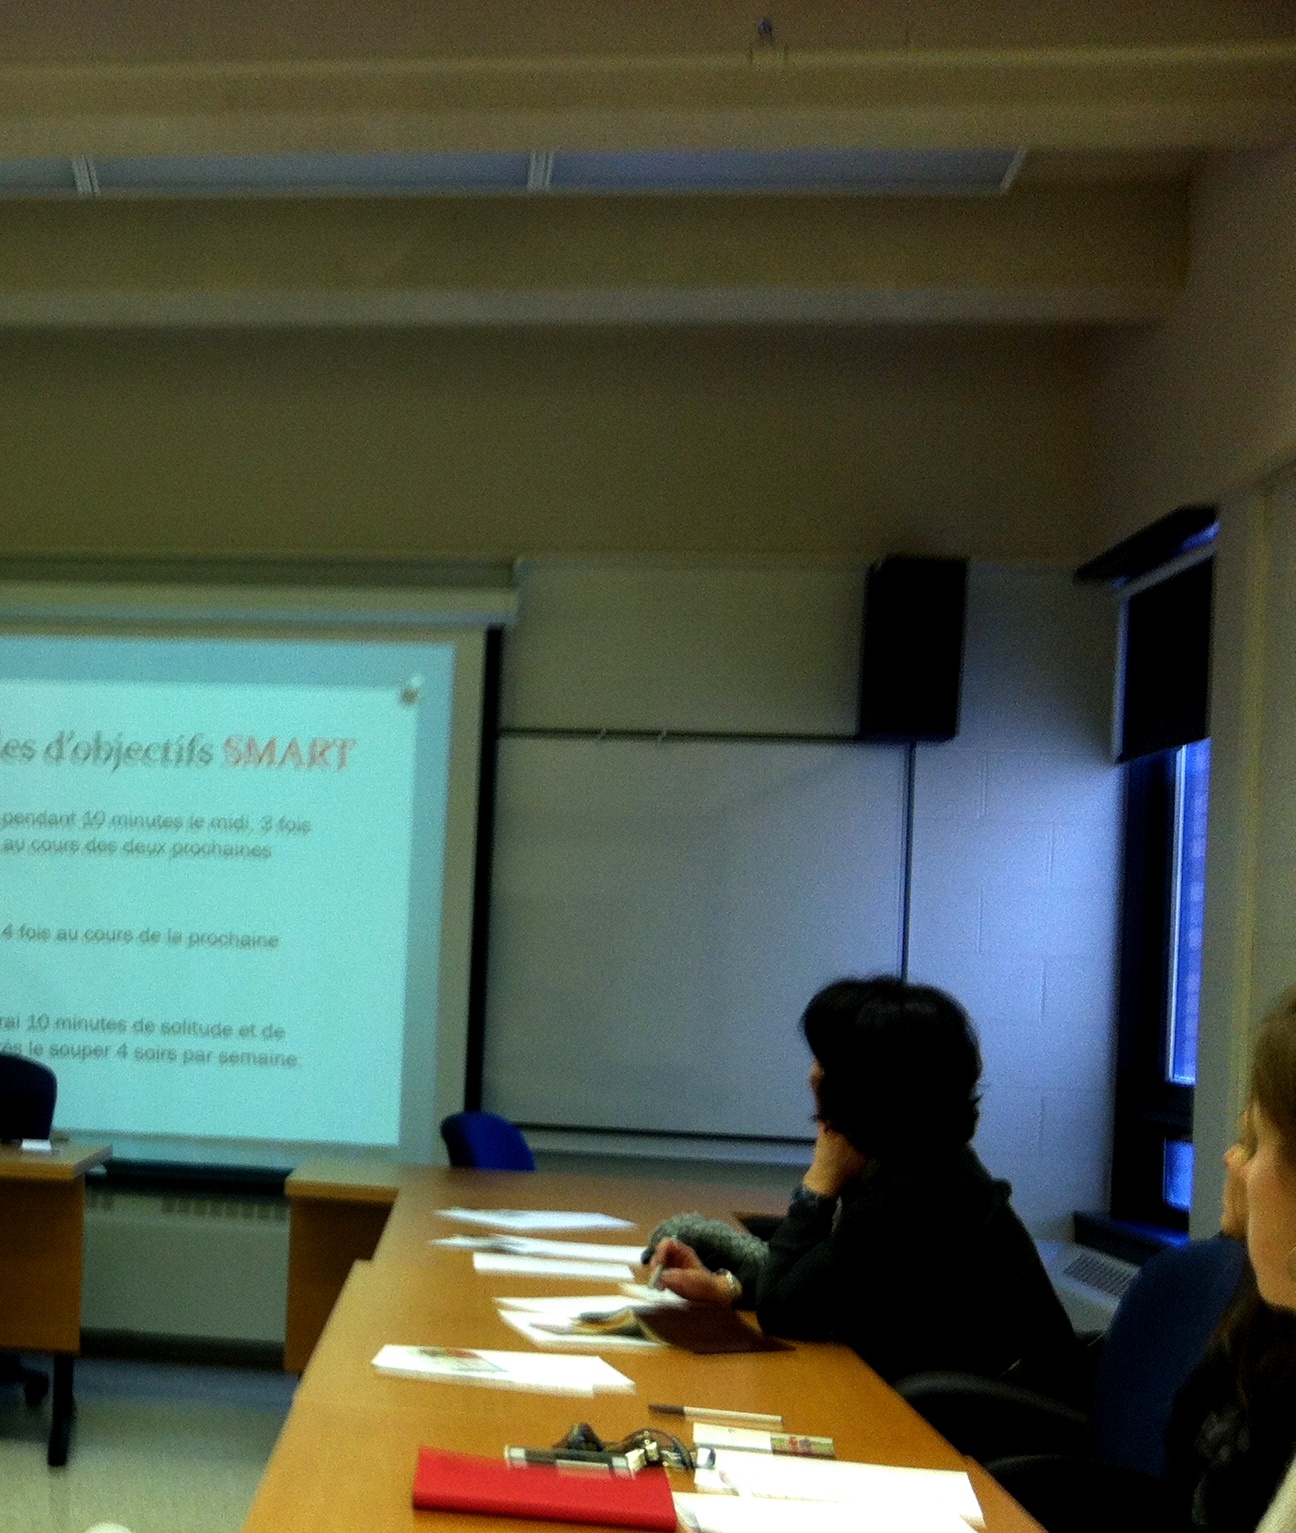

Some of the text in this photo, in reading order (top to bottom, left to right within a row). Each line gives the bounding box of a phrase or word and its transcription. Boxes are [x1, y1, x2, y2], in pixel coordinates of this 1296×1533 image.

[223, 735, 357, 768] SMART
[3, 811, 76, 830] pendant
[82, 811, 106, 828] 10
[111, 814, 184, 830] minutes
[260, 816, 273, 832] 3
[278, 816, 311, 834] fois
[3, 840, 25, 852] au
[30, 839, 80, 853] cours
[85, 838, 117, 854] des
[122, 839, 166, 855] deux
[172, 841, 273, 860] prochaines
[1, 924, 13, 939] 4
[18, 923, 51, 940] fois
[56, 928, 78, 941] au
[84, 928, 134, 943] cours
[138, 928, 161, 944] de
[188, 930, 280, 950] prochaine
[27, 1013, 50, 1031] 10
[55, 1016, 127, 1033] minutes
[132, 1017, 155, 1034] de
[160, 1019, 233, 1038] solitude
[238, 1023, 256, 1038] et
[261, 1022, 286, 1041] de
[28, 1041, 45, 1056] le
[51, 1044, 109, 1062] souper
[115, 1043, 128, 1058] 4
[134, 1045, 177, 1062] soirs
[183, 1049, 211, 1064] par
